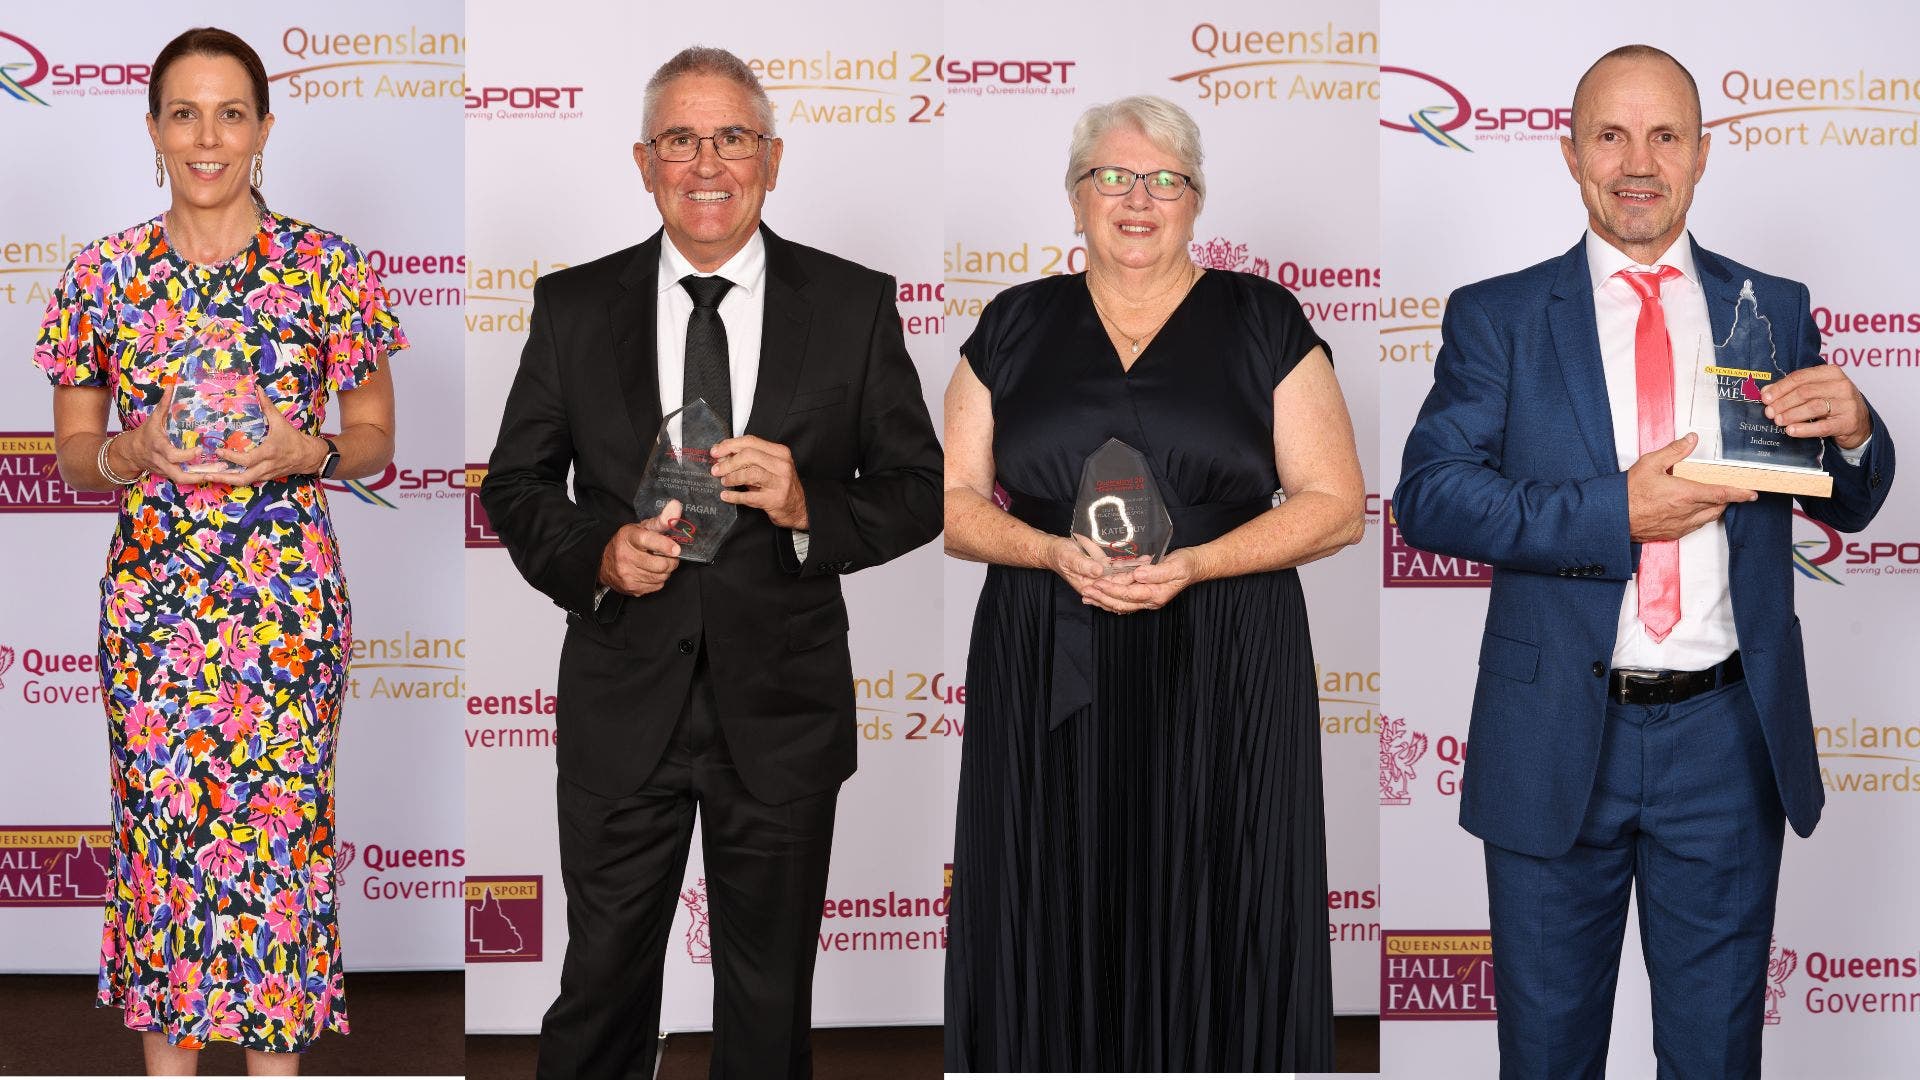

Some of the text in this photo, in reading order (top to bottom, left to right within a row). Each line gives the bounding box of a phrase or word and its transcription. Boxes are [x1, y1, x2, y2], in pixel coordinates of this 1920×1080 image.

[283, 25, 465, 60] Queenslan
[1191, 21, 1378, 58] Queenslan
[52, 64, 152, 86] SPOR
[750, 51, 897, 80] eensland
[52, 86, 147, 97] serving Queensland
[288, 73, 465, 104] Sport Award
[948, 84, 1076, 96] serving Queensland sport
[1198, 74, 1277, 106] Sport
[496, 109, 556, 119] Queensland
[559, 110, 583, 120] sport
[790, 98, 896, 124] Awards
[1475, 108, 1571, 131] SPOR
[1728, 120, 1919, 152] Sport Award
[369, 250, 465, 278] Queens
[1278, 261, 1380, 291] Queens
[1811, 307, 1920, 337] Queens
[1750, 437, 1780, 447] Inductee
[0, 457, 40, 476] ALL
[0, 480, 61, 504] AME
[400, 490, 432, 500] serving
[685, 504, 717, 515] FAGAN
[1101, 526, 1126, 536] KATE
[1391, 551, 1480, 577] FAME
[1846, 542, 1920, 565] SPO
[1846, 568, 1880, 576] serving
[0, 835, 77, 845] EENSLAND
[0, 850, 63, 875] ALL of
[363, 844, 465, 872] Queens
[0, 874, 62, 897] AME
[363, 876, 465, 900] Govern
[494, 885, 536, 896] SPORT
[823, 891, 948, 918] eensland
[1388, 939, 1492, 953] QUEENSLAND
[1388, 957, 1479, 983] HALL of
[1805, 952, 1920, 983] Queens
[1387, 983, 1477, 1010] FAME
